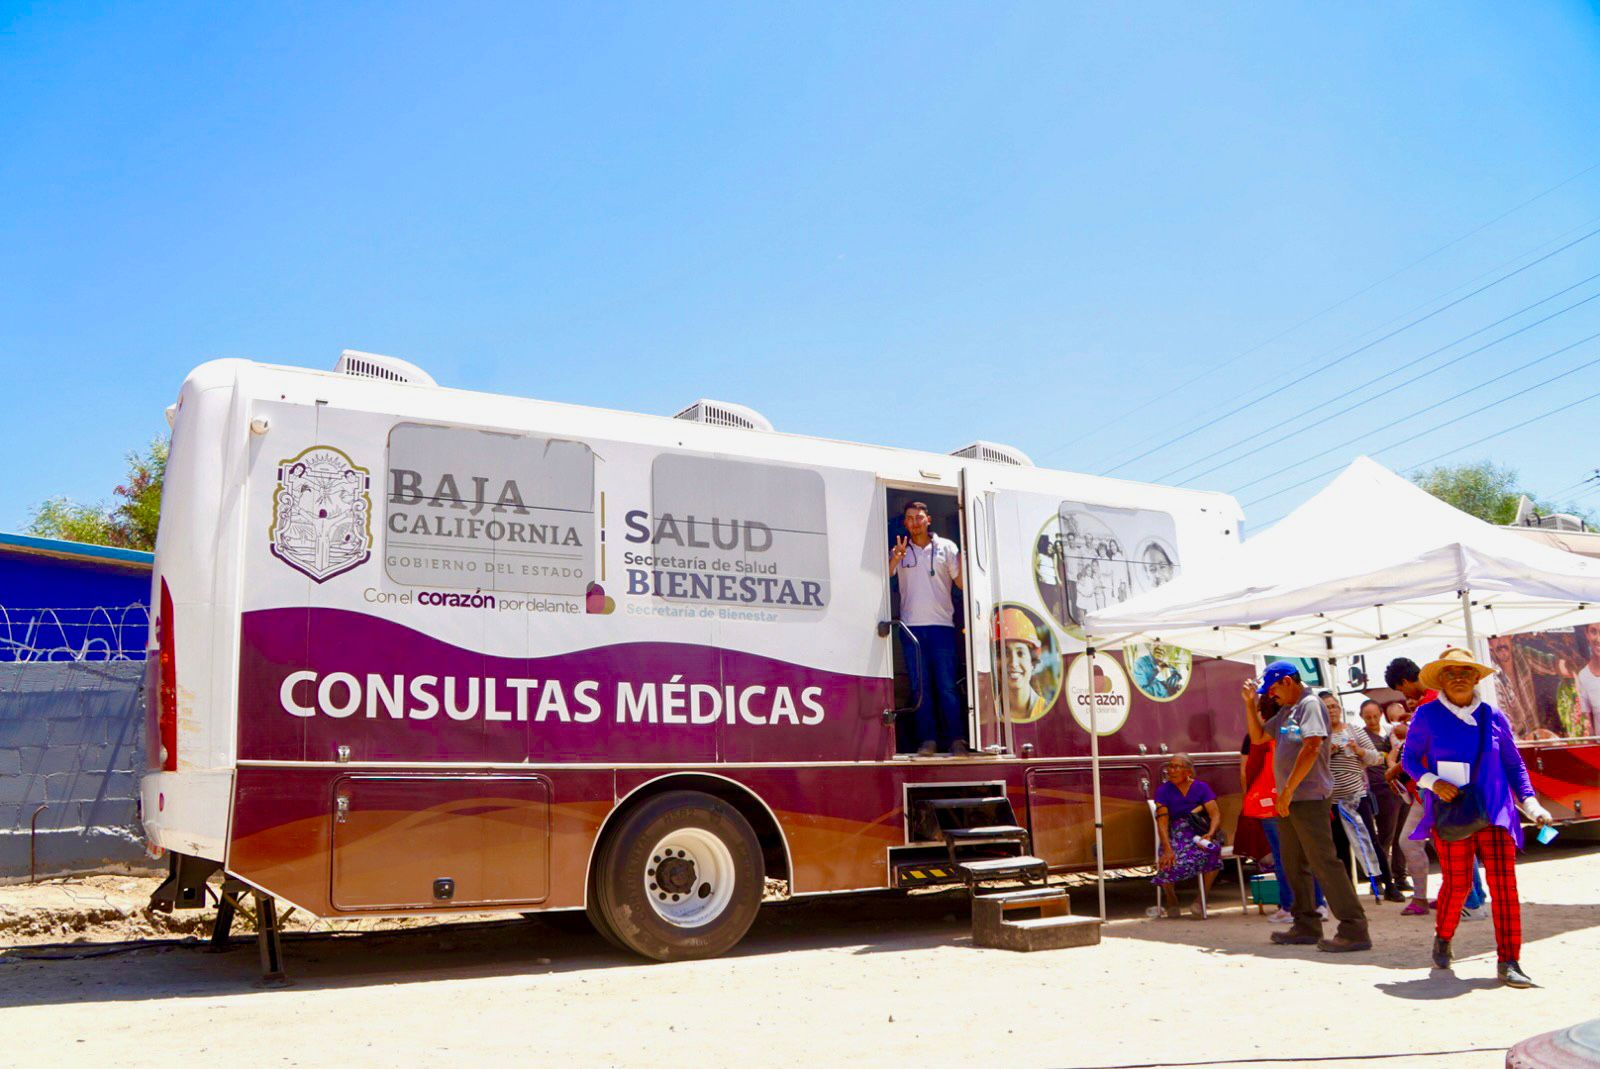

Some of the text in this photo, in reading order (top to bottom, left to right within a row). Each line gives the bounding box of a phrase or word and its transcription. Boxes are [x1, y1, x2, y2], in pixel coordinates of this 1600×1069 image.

[390, 468, 531, 516] BAJA
[388, 512, 584, 548] CALIFORNIA
[624, 510, 773, 552] SALUD
[387, 556, 583, 579] GOBIERNO DEL ESTADO
[624, 552, 777, 575] Secretaría de Salud
[363, 587, 397, 603] Con
[400, 590, 413, 604] el
[417, 587, 496, 609] corazón
[499, 598, 526, 612] por
[625, 568, 825, 607] BIENESTAR
[699, 608, 715, 619] de
[718, 608, 778, 622] Bienestar
[279, 670, 825, 725] CONSULTAS MÉDICAS
[1077, 690, 1125, 706] coazón
